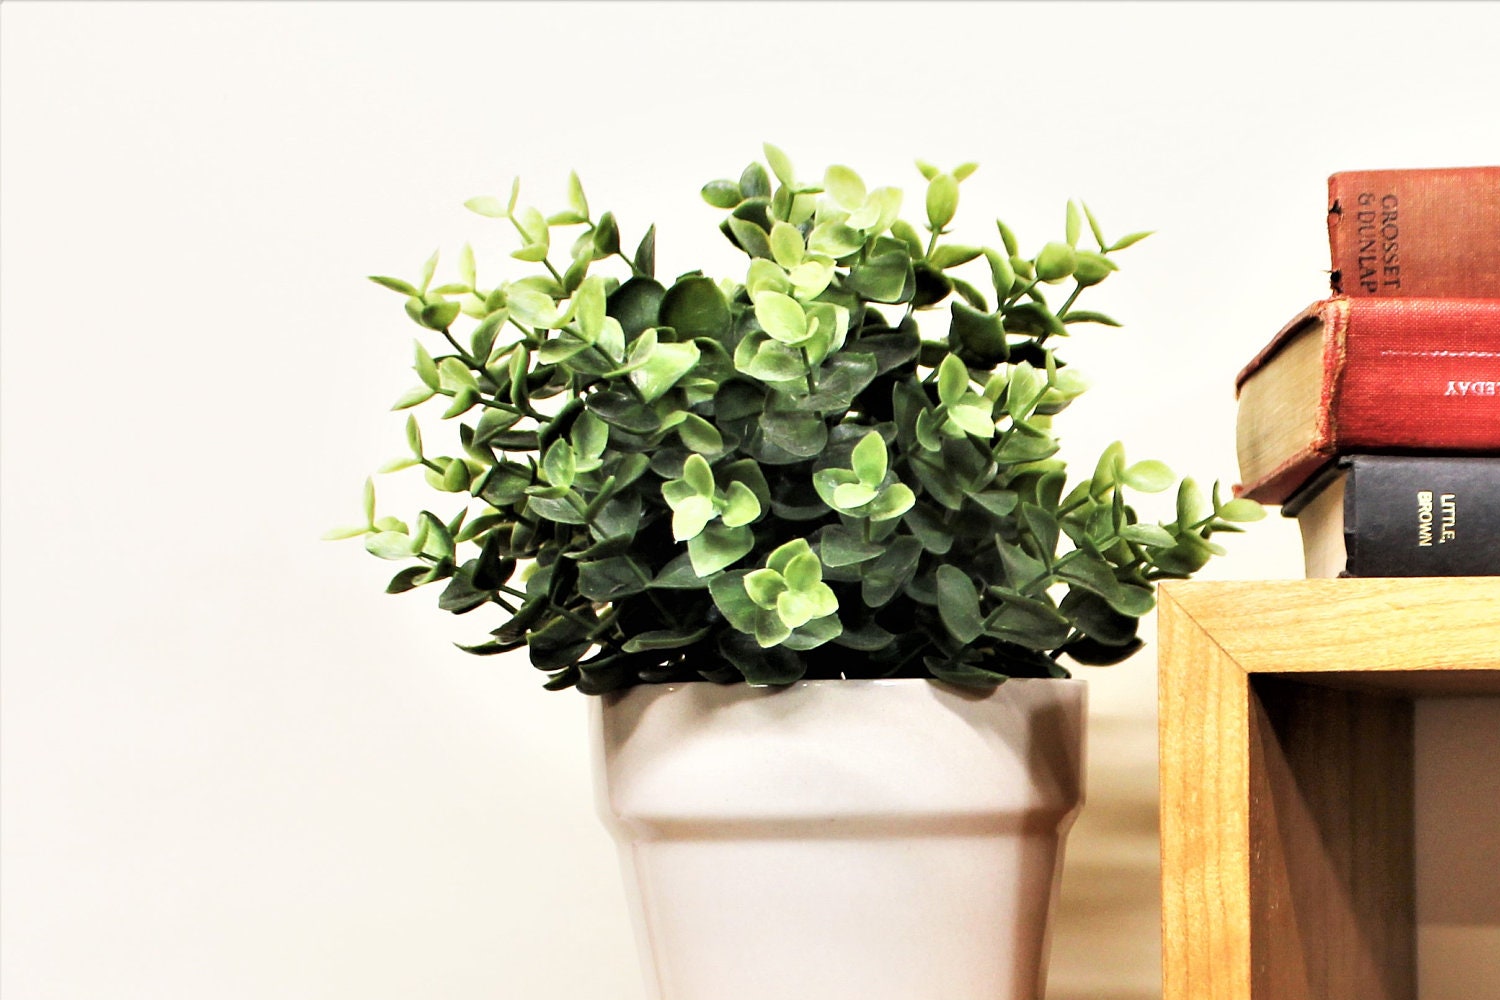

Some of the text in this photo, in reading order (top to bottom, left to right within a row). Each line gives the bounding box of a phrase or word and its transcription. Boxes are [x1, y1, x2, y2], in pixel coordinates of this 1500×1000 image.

[1358, 211, 1378, 293] DUNLAP
[1382, 194, 1400, 289] GROSSET
[1417, 491, 1433, 547] BROWN
[1439, 494, 1456, 544] LITTLE,
